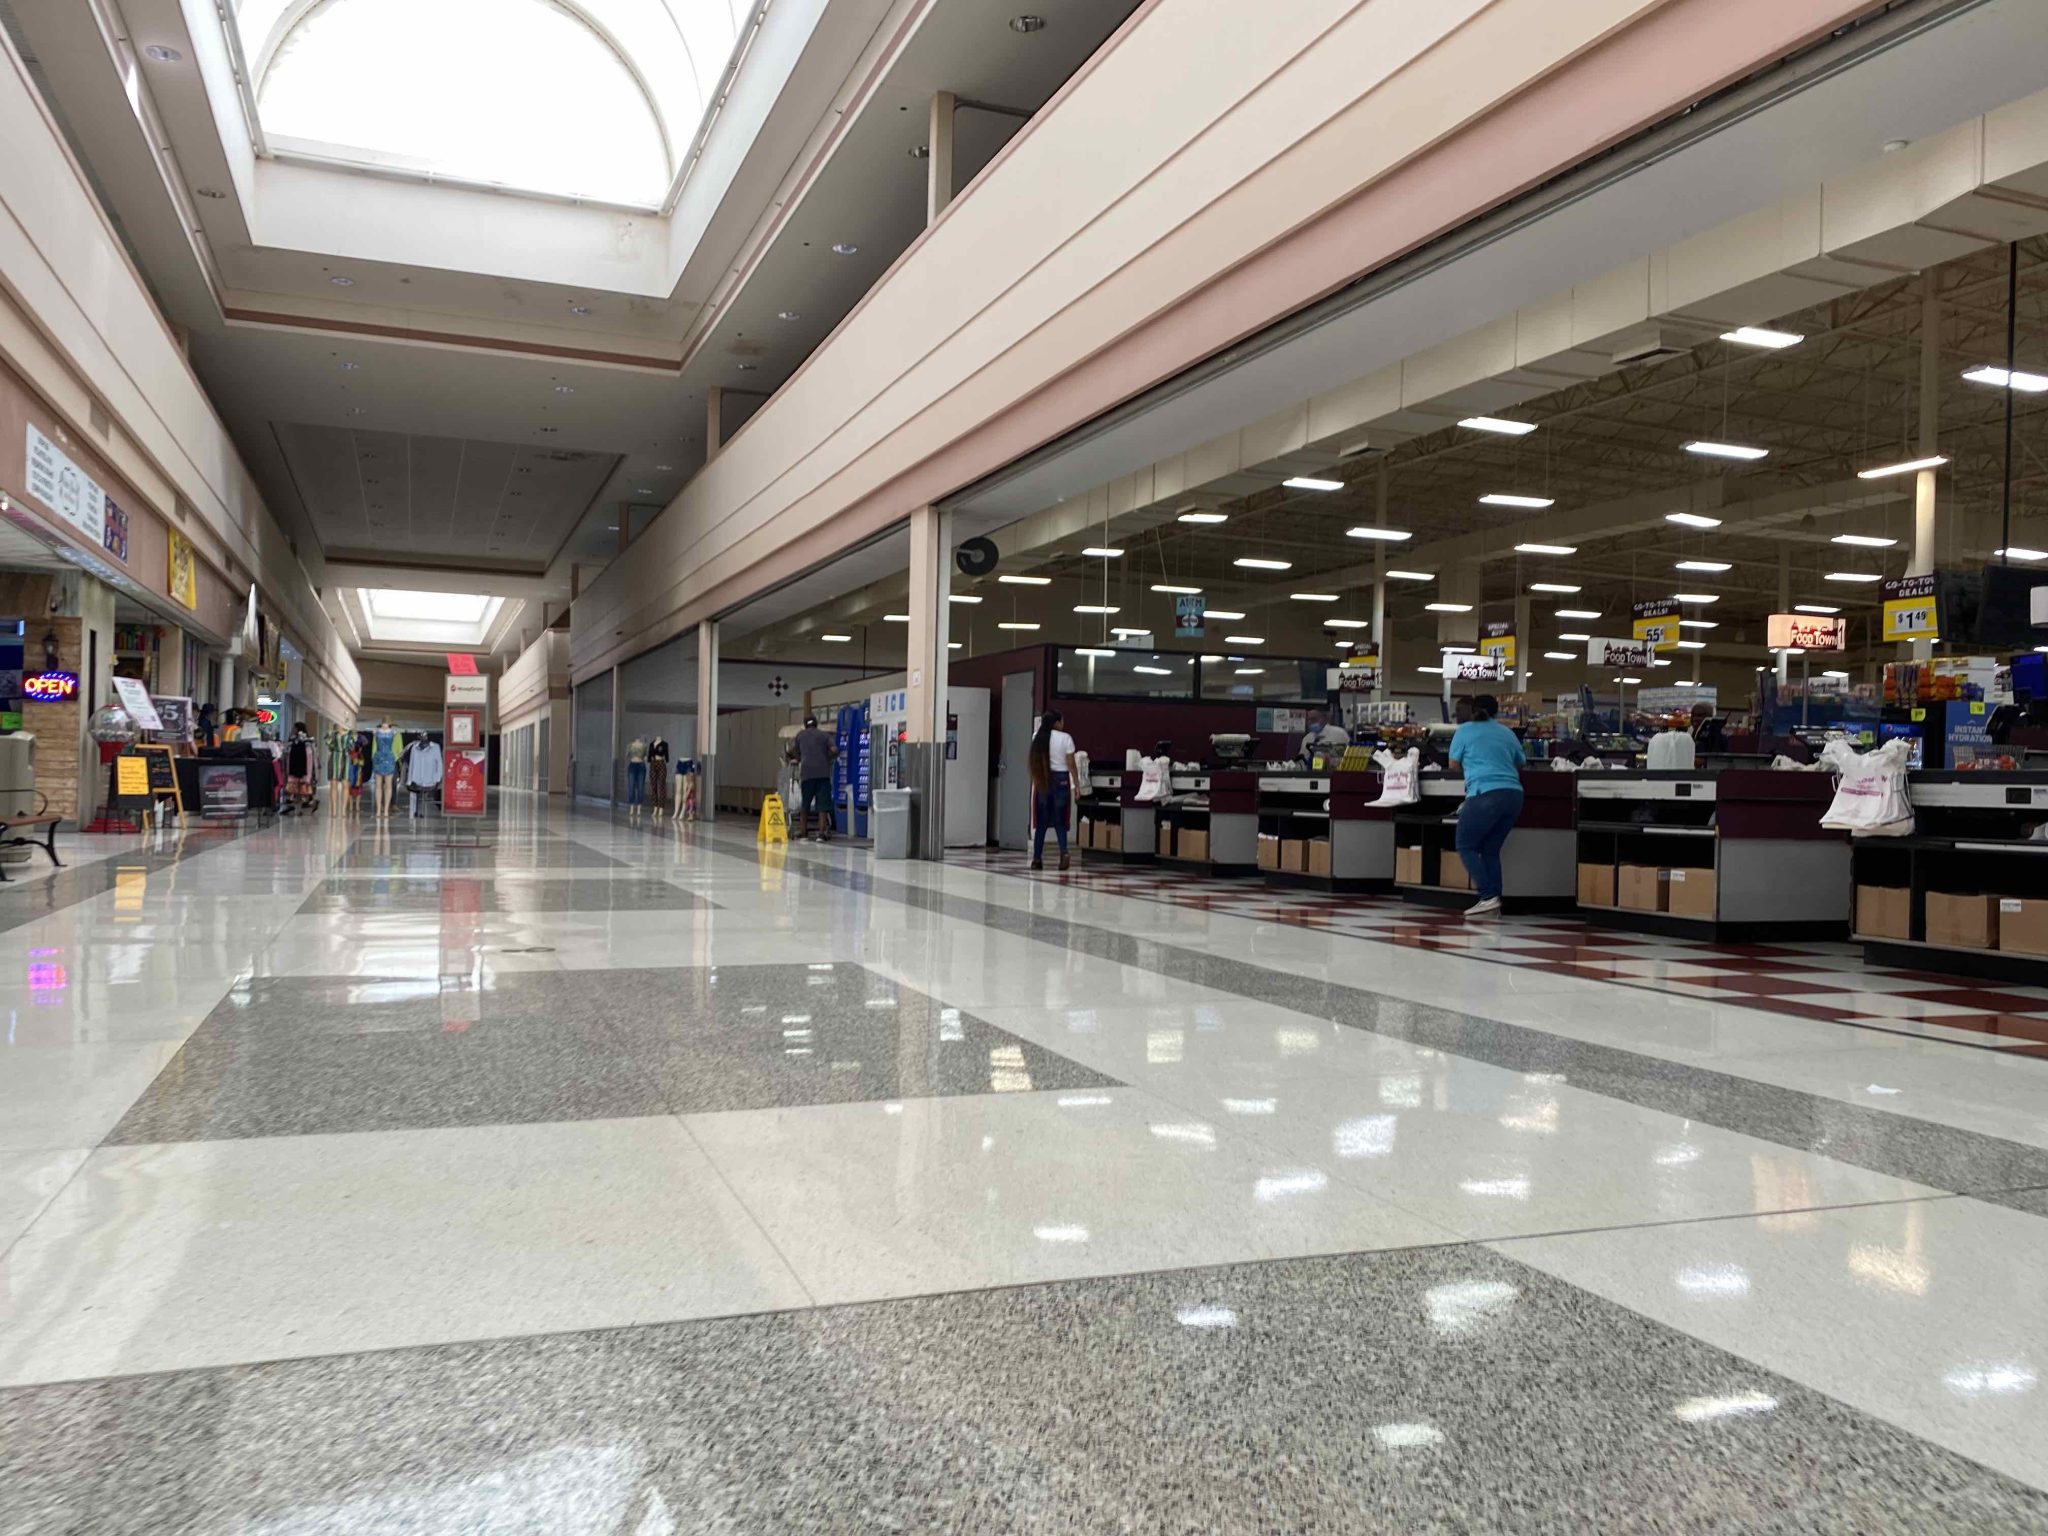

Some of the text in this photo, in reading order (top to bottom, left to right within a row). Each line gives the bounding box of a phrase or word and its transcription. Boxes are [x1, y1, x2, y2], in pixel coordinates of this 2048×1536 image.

[1885, 576, 1935, 591] GO-TO-TO
[1898, 586, 1933, 598] DEALS!
[25, 677, 73, 694] OPEN
[1949, 734, 1992, 743] HYDRATION
